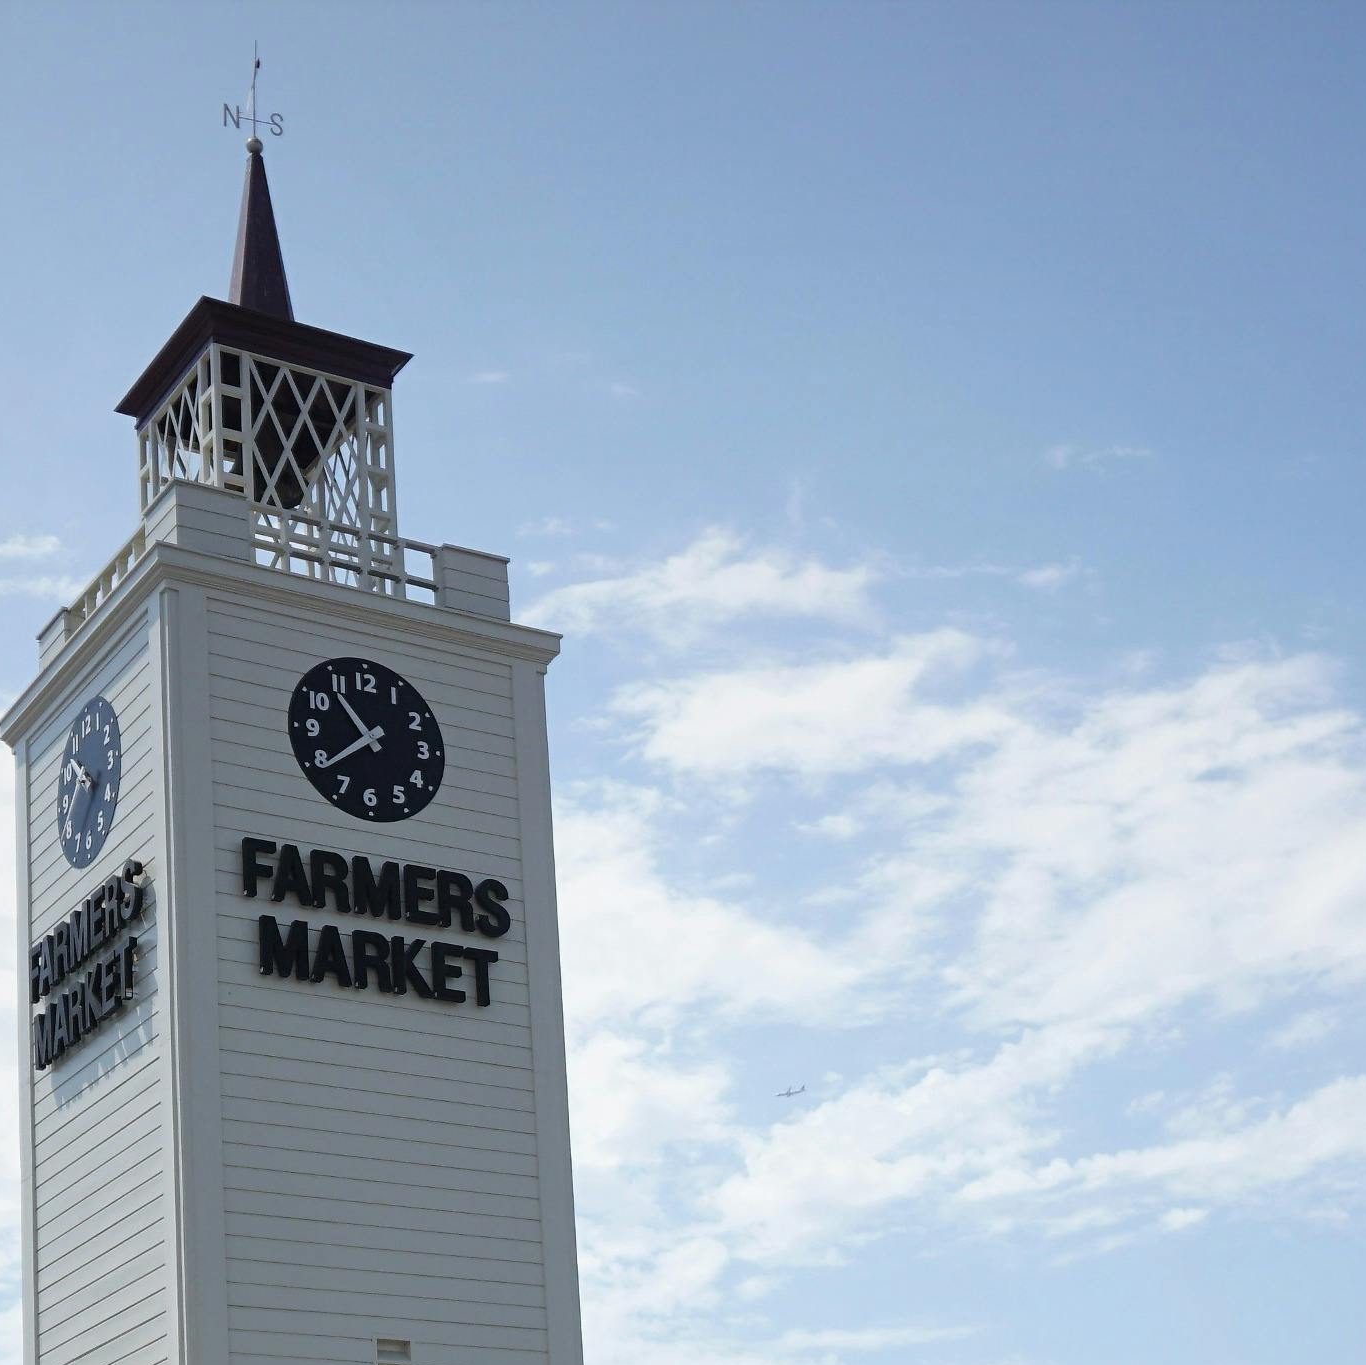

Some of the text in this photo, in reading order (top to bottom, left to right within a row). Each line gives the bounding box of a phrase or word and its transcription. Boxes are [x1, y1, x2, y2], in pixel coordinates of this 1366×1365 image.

[223, 103, 240, 129] N
[270, 112, 284, 137] S
[331, 673, 347, 694] 11
[355, 672, 377, 694] 12
[309, 690, 330, 711] 10
[390, 686, 397, 705] 1
[81, 714, 91, 738] 12
[305, 718, 320, 737] 9
[408, 711, 422, 731] 2
[72, 734, 79, 755] 11
[103, 724, 111, 746] 2
[106, 749, 114, 771] 3
[314, 749, 328, 769] 8
[416, 740, 430, 760] 3
[63, 763, 72, 786] 10
[336, 774, 350, 794] 7
[409, 769, 424, 788] 4
[104, 782, 111, 803] 4
[362, 788, 377, 807] 6
[392, 784, 405, 804] 5
[62, 794, 69, 815] 9
[66, 819, 73, 840] 8
[97, 810, 104, 832] 5
[75, 832, 82, 854] 7
[85, 830, 92, 850] 6
[241, 836, 511, 938] FARMERS
[28, 858, 143, 1004] FARMERS
[258, 914, 498, 1007] MARKET
[34, 936, 137, 1071] MARKET
